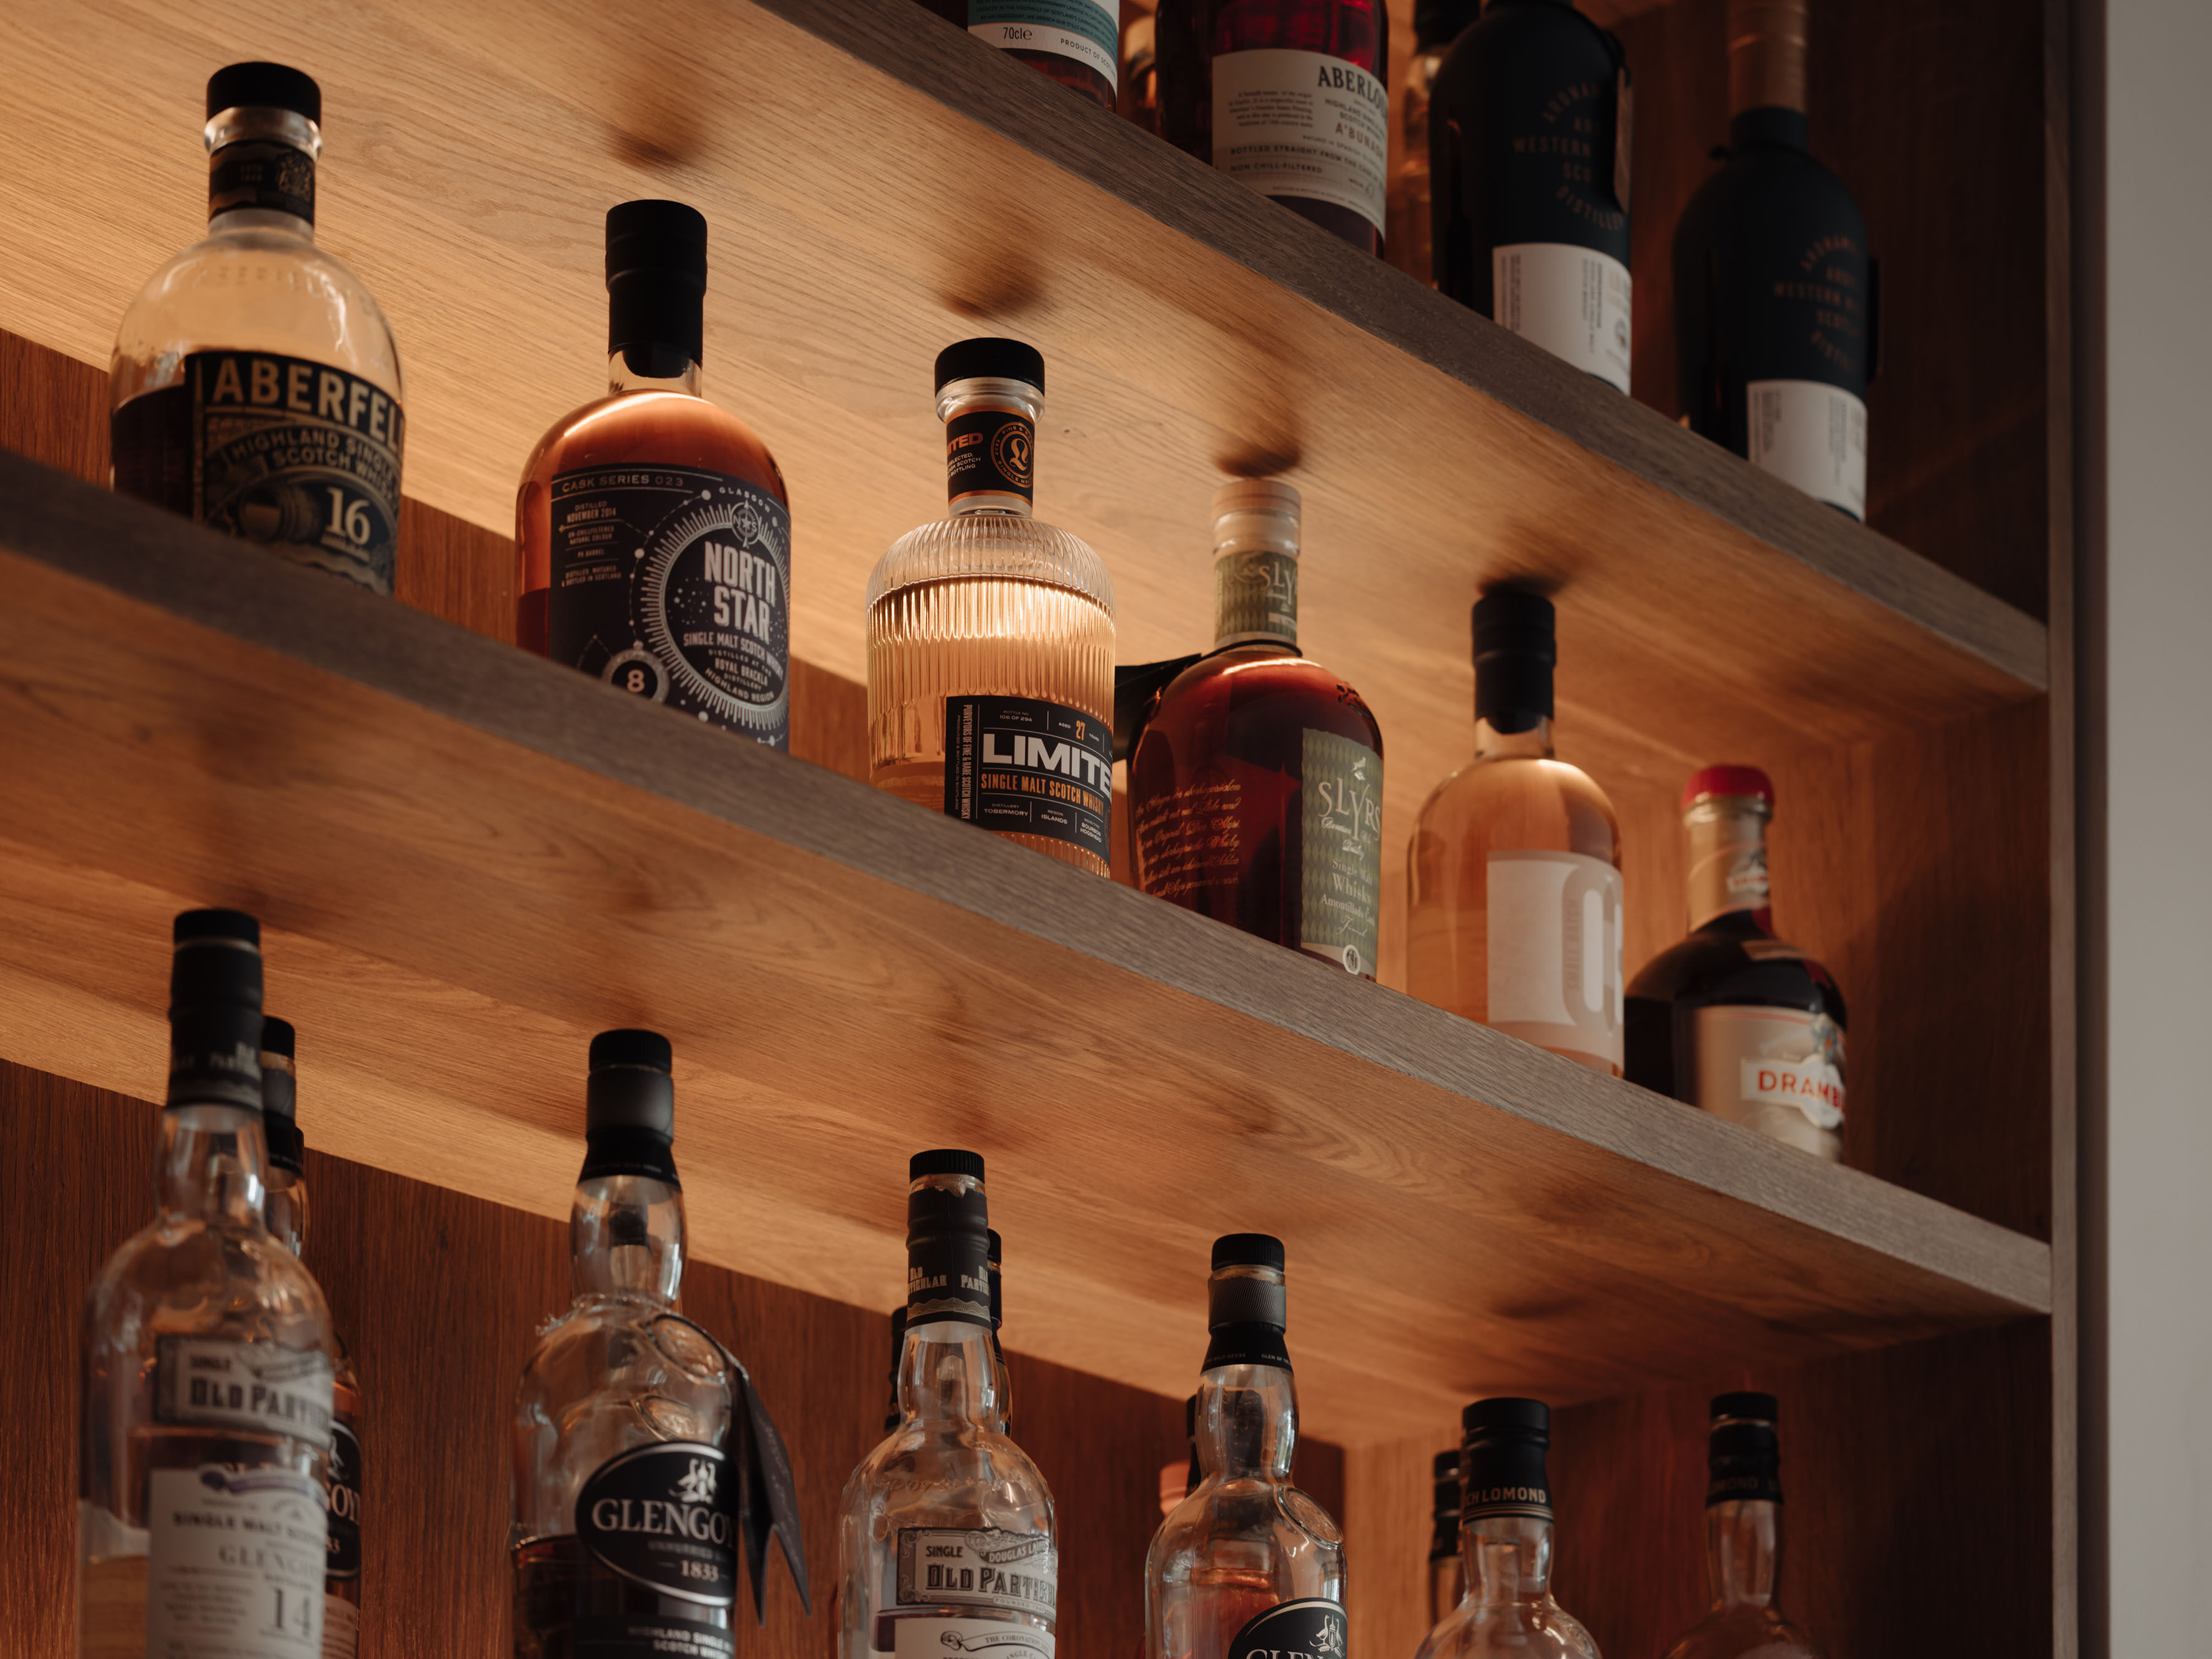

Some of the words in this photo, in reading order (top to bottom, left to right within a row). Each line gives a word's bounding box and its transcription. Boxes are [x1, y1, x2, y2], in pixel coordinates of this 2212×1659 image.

[1061, 38, 1092, 56] PRODUCT
[1093, 51, 1100, 60] OF
[1231, 145, 1270, 155] BOTTLED
[1274, 145, 1317, 155] STRAIGHT
[1320, 150, 1342, 162] FROM
[1513, 135, 1591, 157] WESTERN
[1563, 161, 1593, 183] SCO
[212, 356, 404, 453] ABERFEL
[232, 429, 340, 461] HIGHLAND
[272, 446, 351, 471] SCOTCH
[956, 456, 981, 467] SCOTCH
[950, 464, 976, 476] BOTTLING
[998, 460, 1019, 482] SINGLE
[562, 477, 595, 493] CASK
[599, 474, 650, 486] SERIES
[655, 476, 684, 487] 023
[574, 500, 607, 512] DISTILLED
[719, 486, 771, 513] GLASGOW
[326, 486, 371, 547] 16
[566, 508, 599, 524] NOVEMBER
[601, 507, 617, 519] 2014
[569, 536, 590, 546] NATURAL
[566, 575, 586, 587] BOTTLED
[587, 574, 593, 582] IN
[594, 572, 622, 581] SCOTLAND
[592, 565, 616, 574] MATURED
[704, 540, 776, 609] NORTH
[1258, 561, 1297, 605] SLY
[714, 585, 770, 645] STAR
[683, 632, 714, 647] SINGLE
[717, 632, 739, 649] MALT
[740, 637, 766, 662] SCOTCH
[707, 648, 749, 663] DISTILLED
[752, 659, 759, 668] AT
[761, 665, 772, 677] THE
[714, 657, 739, 675] ROYAL
[740, 664, 769, 687] BRACKLA
[626, 668, 646, 693] 8
[705, 667, 750, 700] HIGHLAND
[750, 690, 775, 703] REGION
[724, 672, 762, 692] DISTILLERY
[963, 704, 973, 737] PURVEYORS
[1076, 719, 1086, 741] 27
[1088, 733, 1099, 742] YEARS
[962, 744, 972, 756] FINE
[961, 761, 972, 776] RARE
[982, 733, 1112, 801] LIMITE
[961, 776, 971, 798] SCOTCH
[981, 773, 1018, 791] SINGLE
[1021, 776, 1046, 795] MALT
[1049, 780, 1081, 805] SCOTCH
[1083, 790, 1104, 818] WHISKY
[961, 797, 971, 819] WHISKY
[984, 808, 1029, 817] TOBERMORY
[1317, 776, 1381, 842] SLYRS
[1041, 814, 1068, 825] ISLANDS
[1081, 822, 1102, 838] BOURBON
[1080, 828, 1103, 843] HOGSHEAD
[1332, 858, 1358, 878] Single
[1332, 873, 1372, 904] Whisky
[1320, 893, 1364, 919] Amontillado
[1336, 914, 1369, 938] Finish
[1758, 1069, 1844, 1108] DRAMB
[190, 1376, 242, 1409] OLD
[1482, 1486, 1547, 1504] LOMOND
[172, 1512, 235, 1529] SINGLE
[591, 1497, 732, 1548] GLENGO
[926, 1545, 964, 1558] SINGLE
[988, 1545, 1027, 1563] DOUGLAS
[681, 1559, 719, 1583] 1833
[925, 1564, 974, 1592] OLD
[995, 1598, 1030, 1608] FOUNDED
[985, 1636, 1000, 1644] THE
[1001, 1635, 1041, 1647] CORONATION
